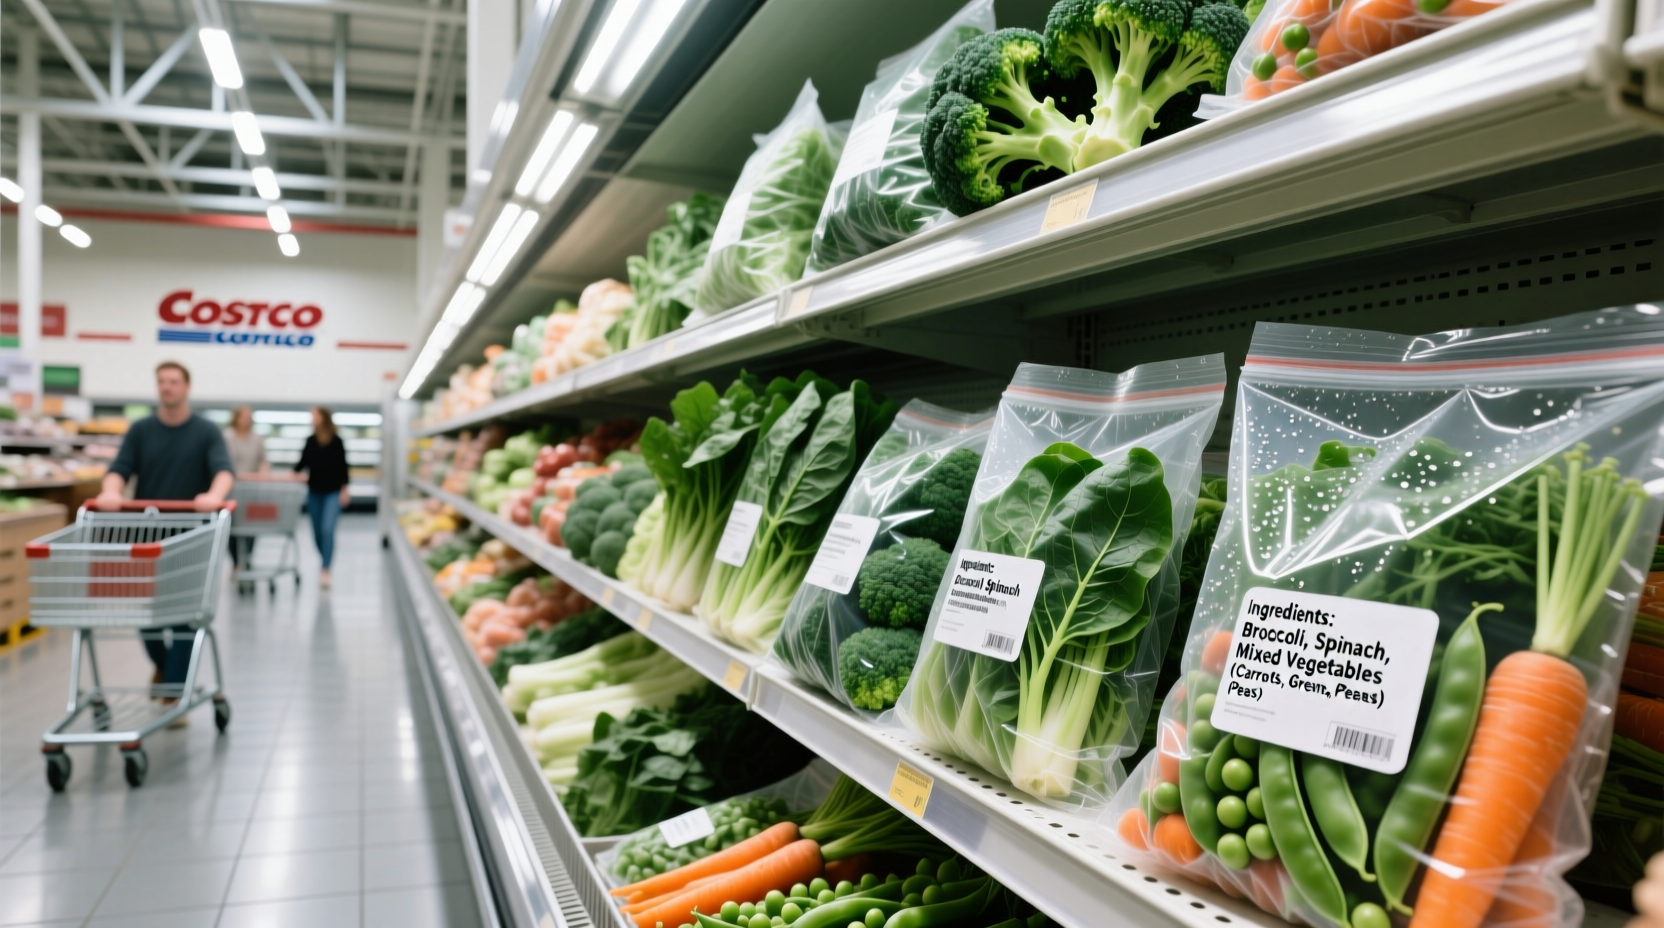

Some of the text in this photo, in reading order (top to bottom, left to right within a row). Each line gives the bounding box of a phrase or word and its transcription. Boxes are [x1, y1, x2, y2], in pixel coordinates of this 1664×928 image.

[1247, 599, 1336, 627] Ingredients:
[1235, 642, 1384, 685] Mixed Vegetables
[1241, 621, 1391, 666] Broccoli, Spinach,
